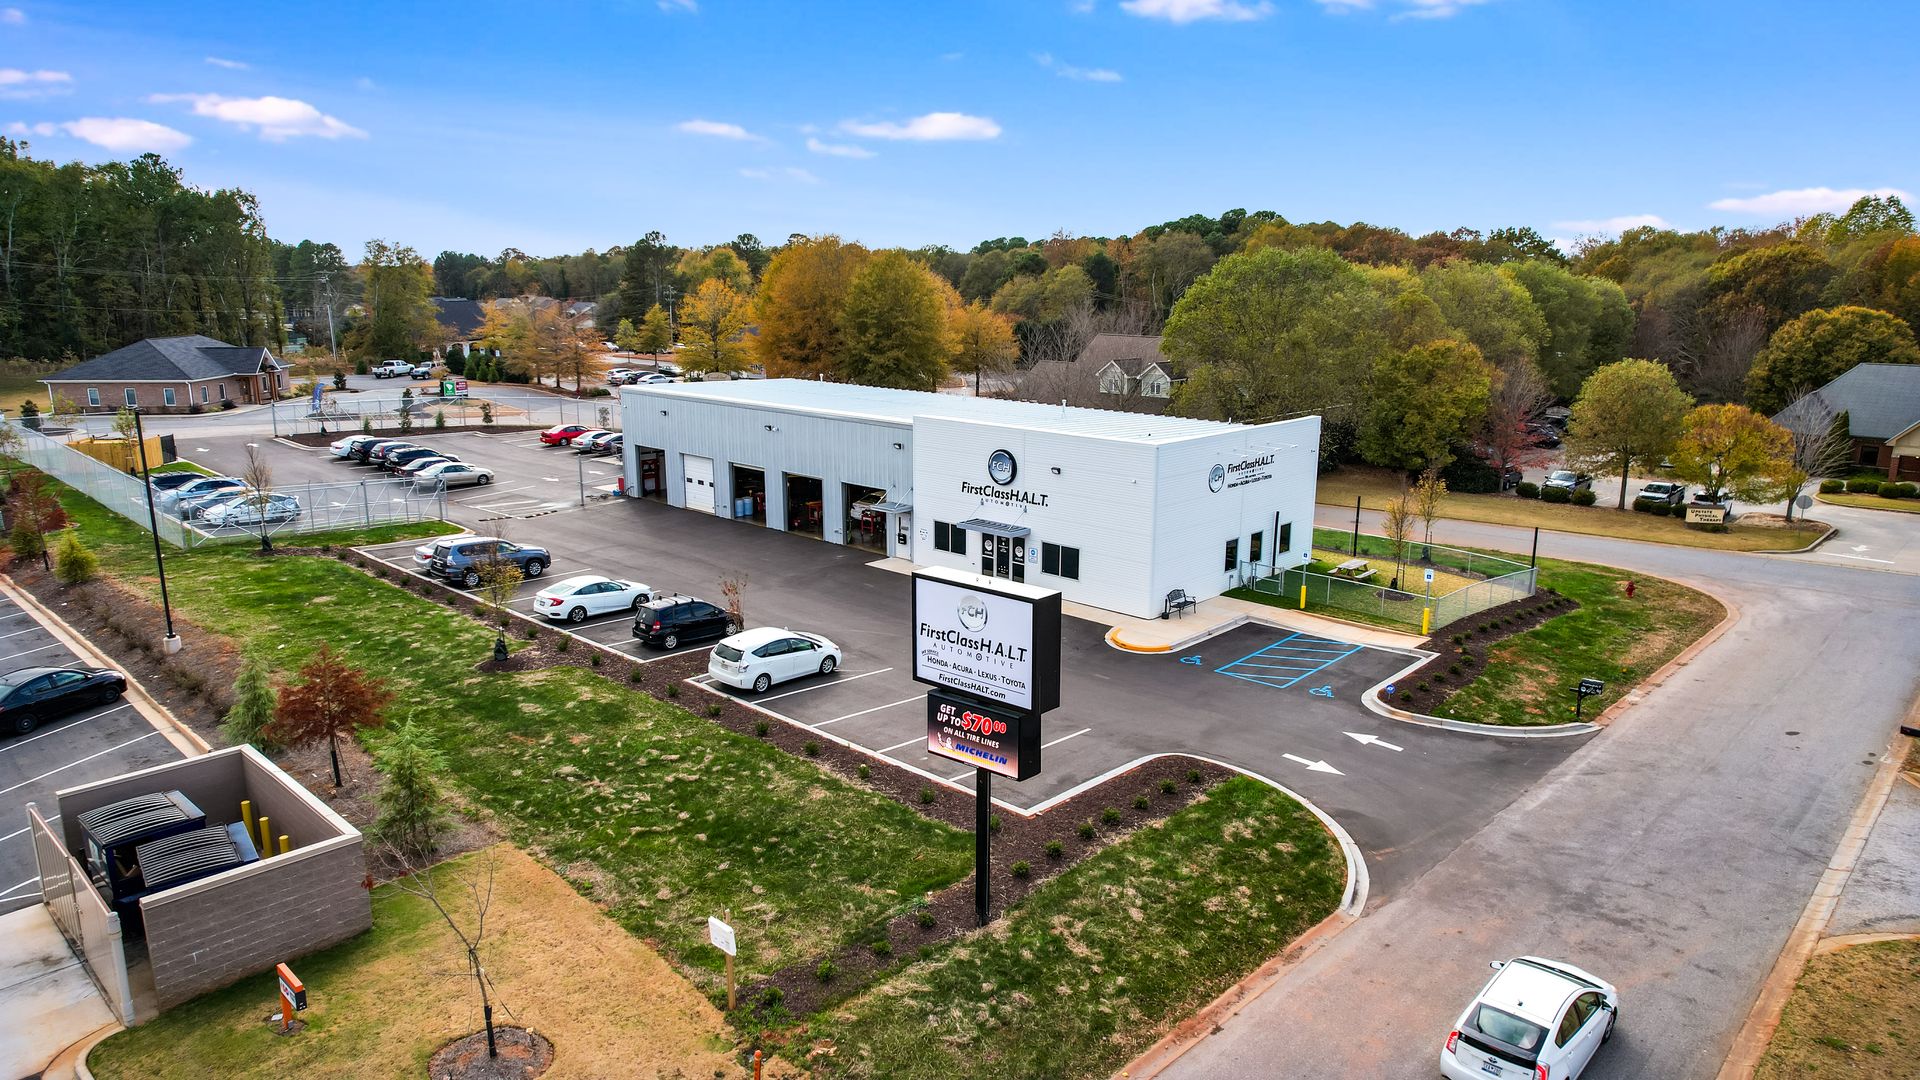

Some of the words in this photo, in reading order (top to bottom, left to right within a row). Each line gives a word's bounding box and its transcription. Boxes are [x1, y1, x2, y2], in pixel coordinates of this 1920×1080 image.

[992, 461, 1010, 472] FCH
[962, 482, 1048, 507] FirstClassH.A.L.T.
[920, 622, 1027, 662] FirstClassH.A.L.T.
[933, 643, 1014, 669] AUTOMOTIVE
[927, 655, 948, 668] HONDA
[952, 662, 973, 674] ACURA
[977, 669, 997, 681] LEXUS
[1001, 676, 1026, 689] TOYOTA
[939, 674, 1006, 699] FirstClassHALT.com
[937, 713, 948, 722] UP
[950, 716, 960, 726] TO
[940, 704, 956, 715] GET
[943, 726, 953, 735] ON
[954, 728, 965, 738] ALL
[966, 733, 980, 743] TIRE
[981, 737, 1000, 748] LINES
[956, 743, 1007, 765] MICHELIN
